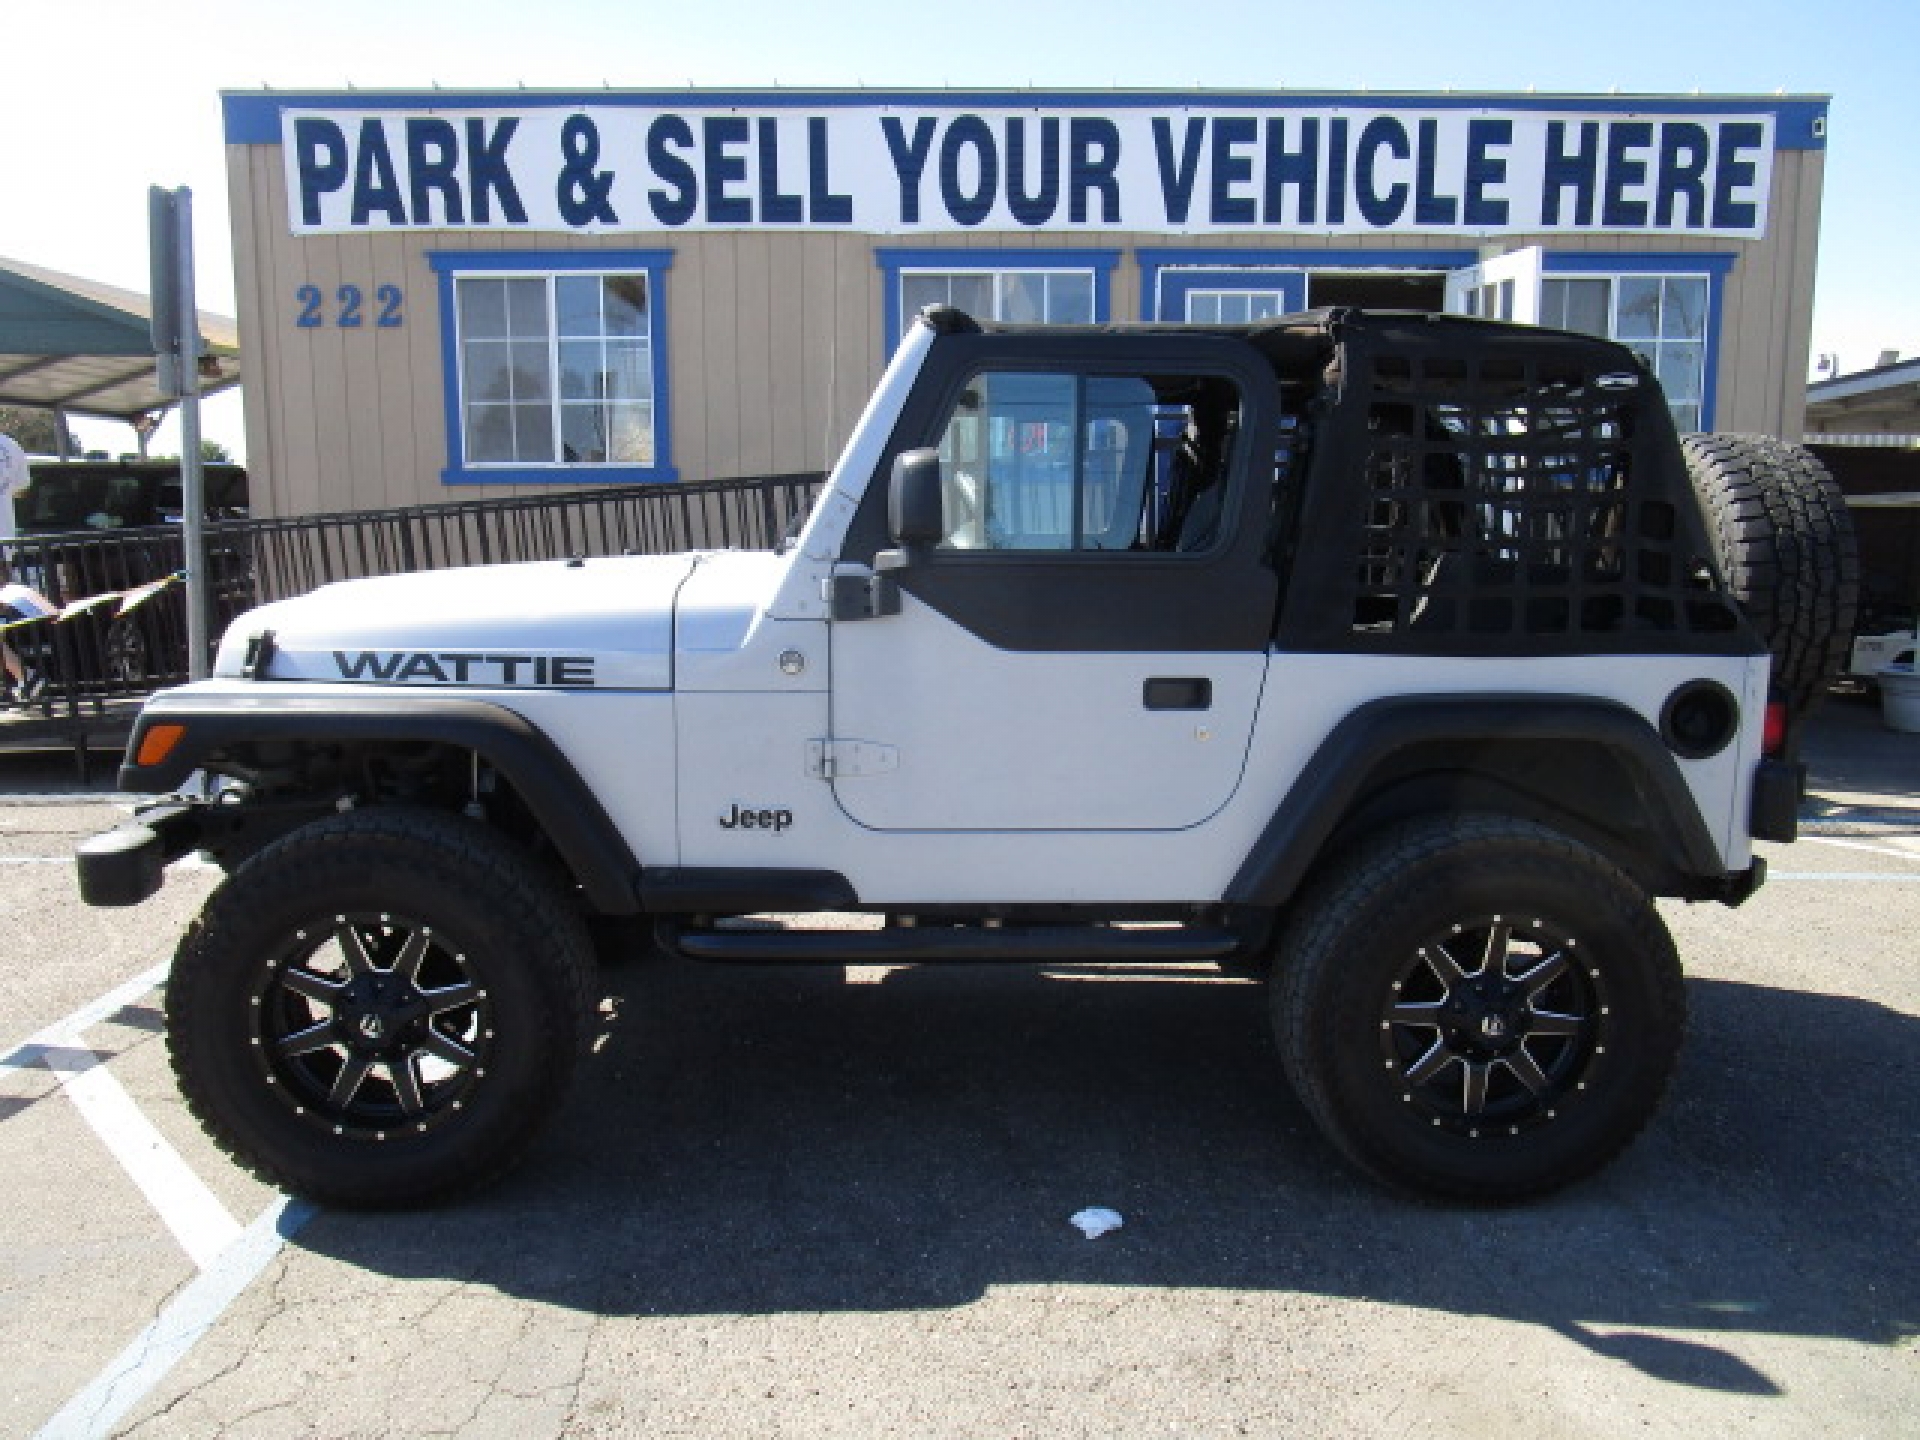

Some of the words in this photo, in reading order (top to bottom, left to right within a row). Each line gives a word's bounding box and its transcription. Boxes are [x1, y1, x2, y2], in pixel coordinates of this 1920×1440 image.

[296, 116, 528, 226] PARK
[556, 113, 619, 226] &
[646, 113, 853, 226] SELL
[880, 115, 1120, 226] YOUR
[1150, 116, 1512, 226] VEHICLE
[1544, 121, 1763, 227] HERE
[296, 284, 404, 328] 222
[332, 650, 595, 685] WATTIE
[719, 803, 793, 832] Jeep
